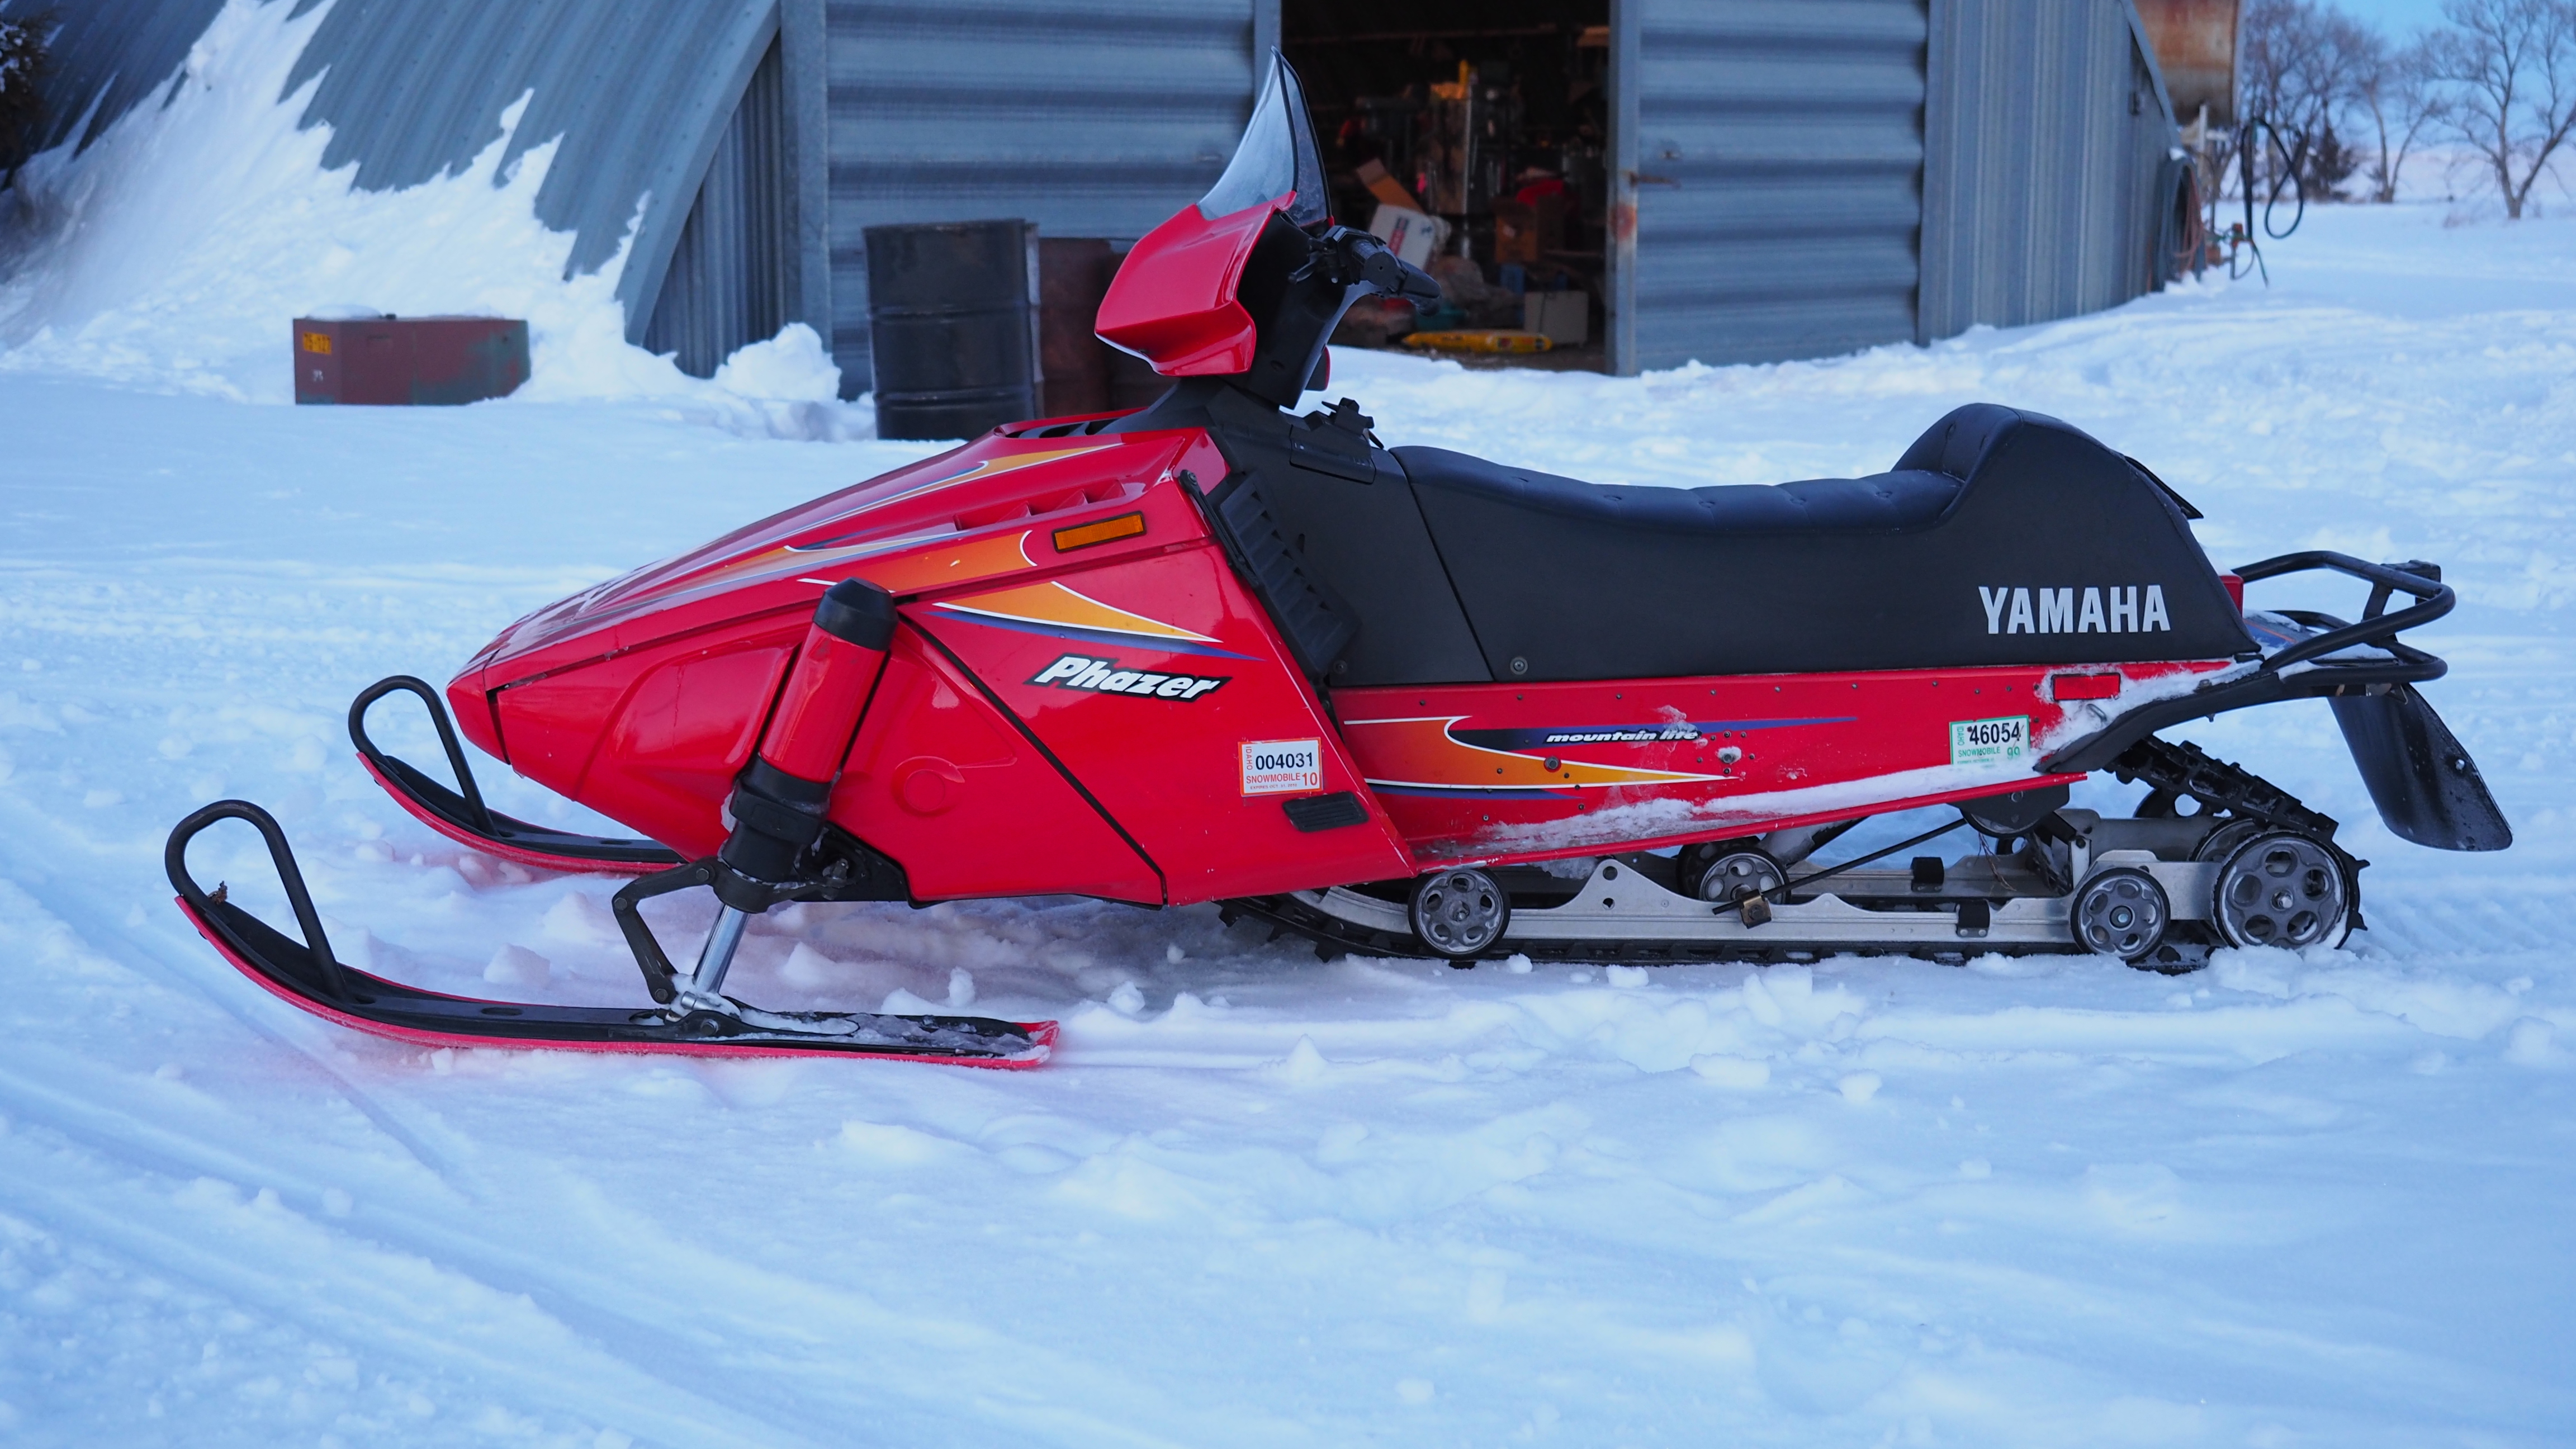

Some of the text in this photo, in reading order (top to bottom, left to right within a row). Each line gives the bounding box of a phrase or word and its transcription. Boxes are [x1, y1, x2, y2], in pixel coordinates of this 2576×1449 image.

[1978, 584, 2171, 634] YAMAHA
[1034, 656, 1221, 699] Phazer
[1546, 730, 1657, 742] mountain
[1969, 721, 2021, 745] 46054
[1958, 746, 2000, 757] SNOWMOBILE
[1256, 752, 1313, 770] 004031
[1246, 773, 1300, 784] SNOWMOBILE
[1302, 772, 1318, 786] 10
